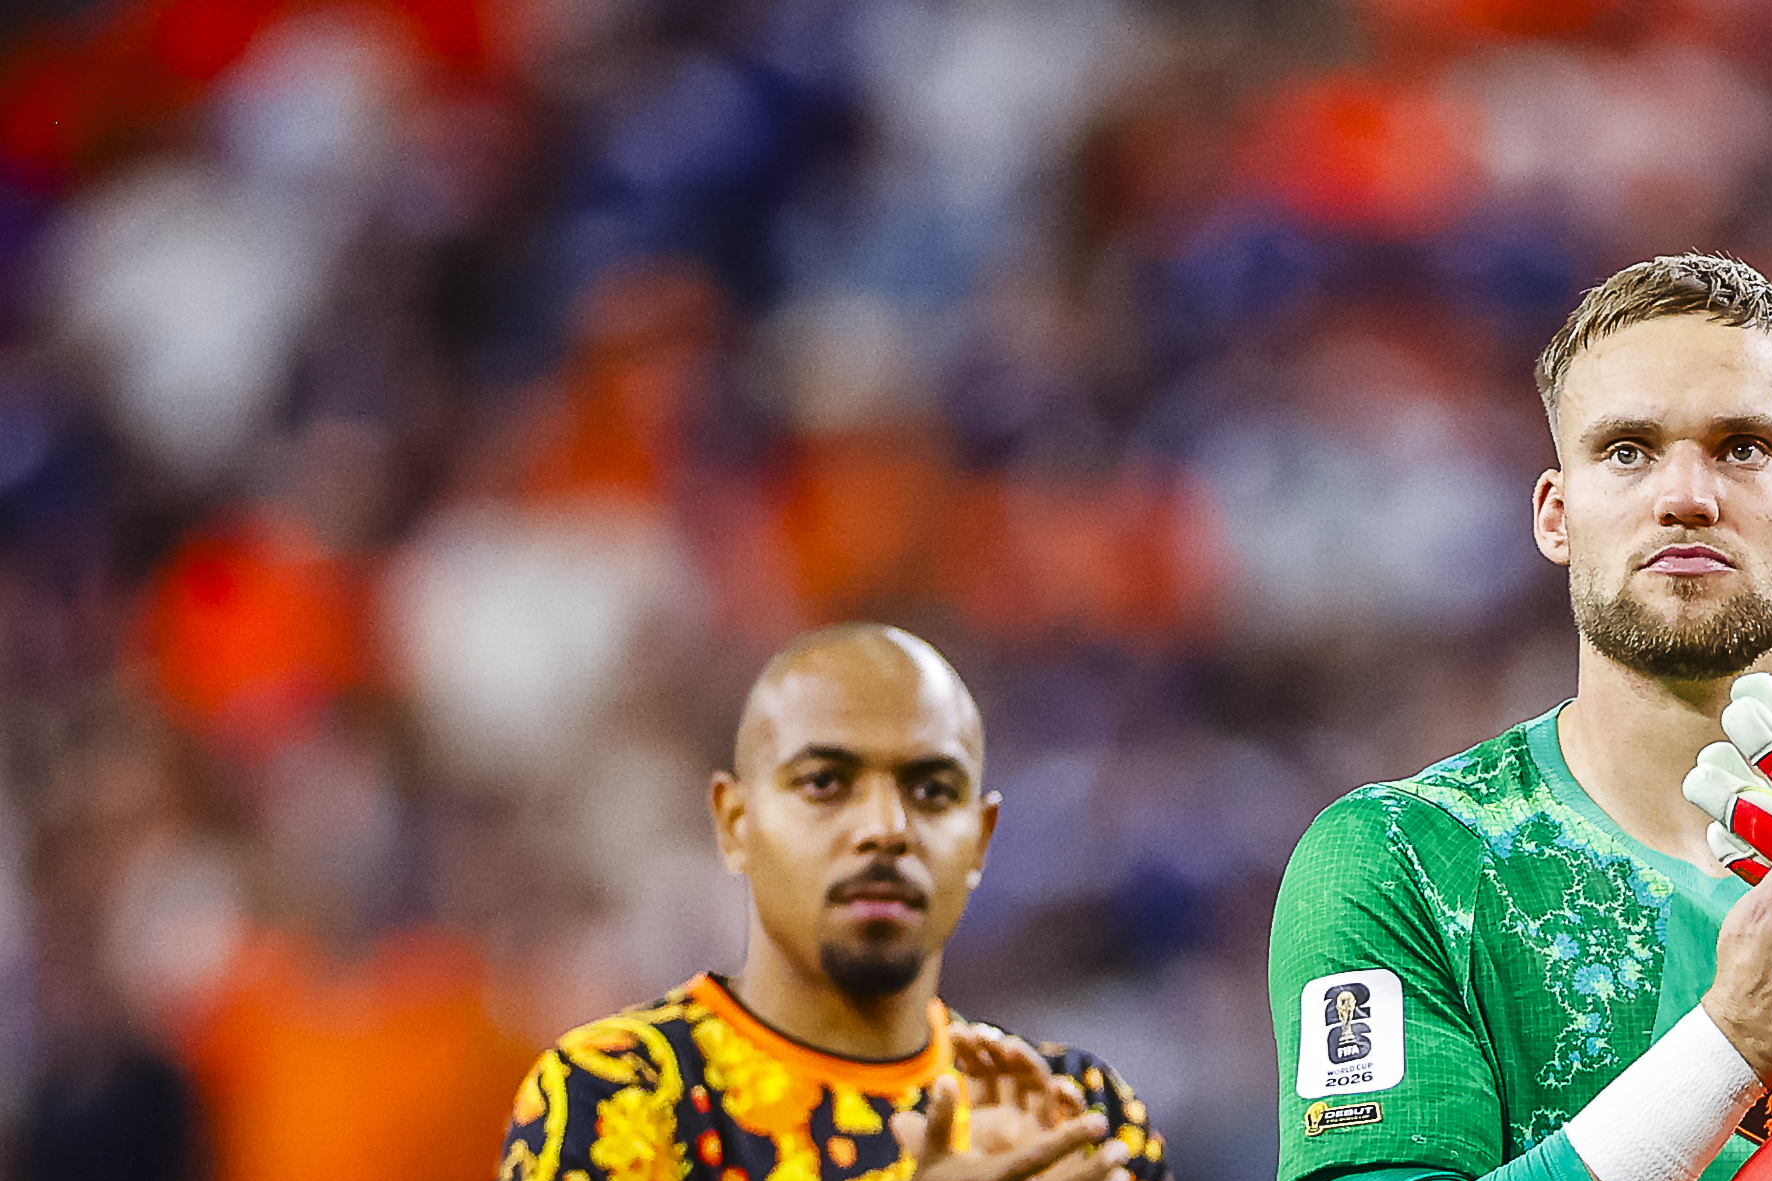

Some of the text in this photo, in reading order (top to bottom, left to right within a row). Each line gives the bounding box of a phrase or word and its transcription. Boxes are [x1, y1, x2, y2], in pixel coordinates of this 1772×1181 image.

[1327, 1062, 1374, 1076] WORLD CUP
[1325, 1071, 1373, 1087] 2026
[1324, 1106, 1374, 1119] DEBUT
